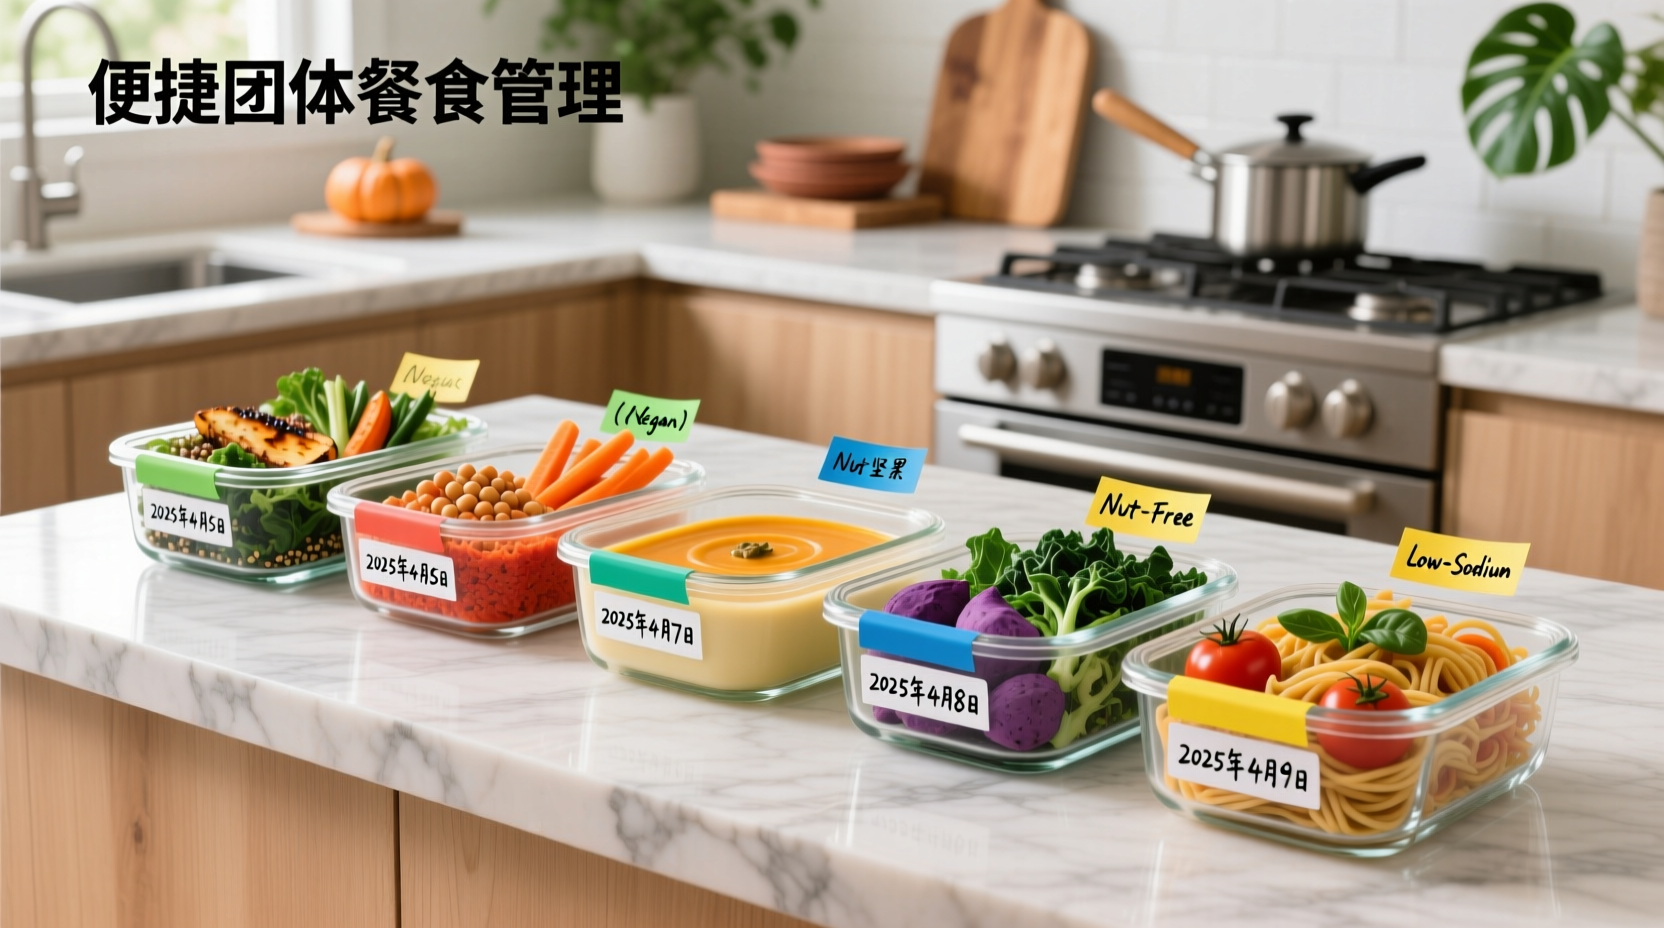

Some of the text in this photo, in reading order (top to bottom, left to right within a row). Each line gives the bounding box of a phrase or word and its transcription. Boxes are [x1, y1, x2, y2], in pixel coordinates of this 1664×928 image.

[150, 503, 225, 534] 2025年4月5日
[1099, 493, 1193, 527] Nut-Free
[366, 553, 448, 588] 2025年4月5日
[601, 609, 693, 645] 2025年4月7日
[869, 672, 978, 715] 2025年4月8日
[1178, 744, 1307, 792] 2025年4月9日
